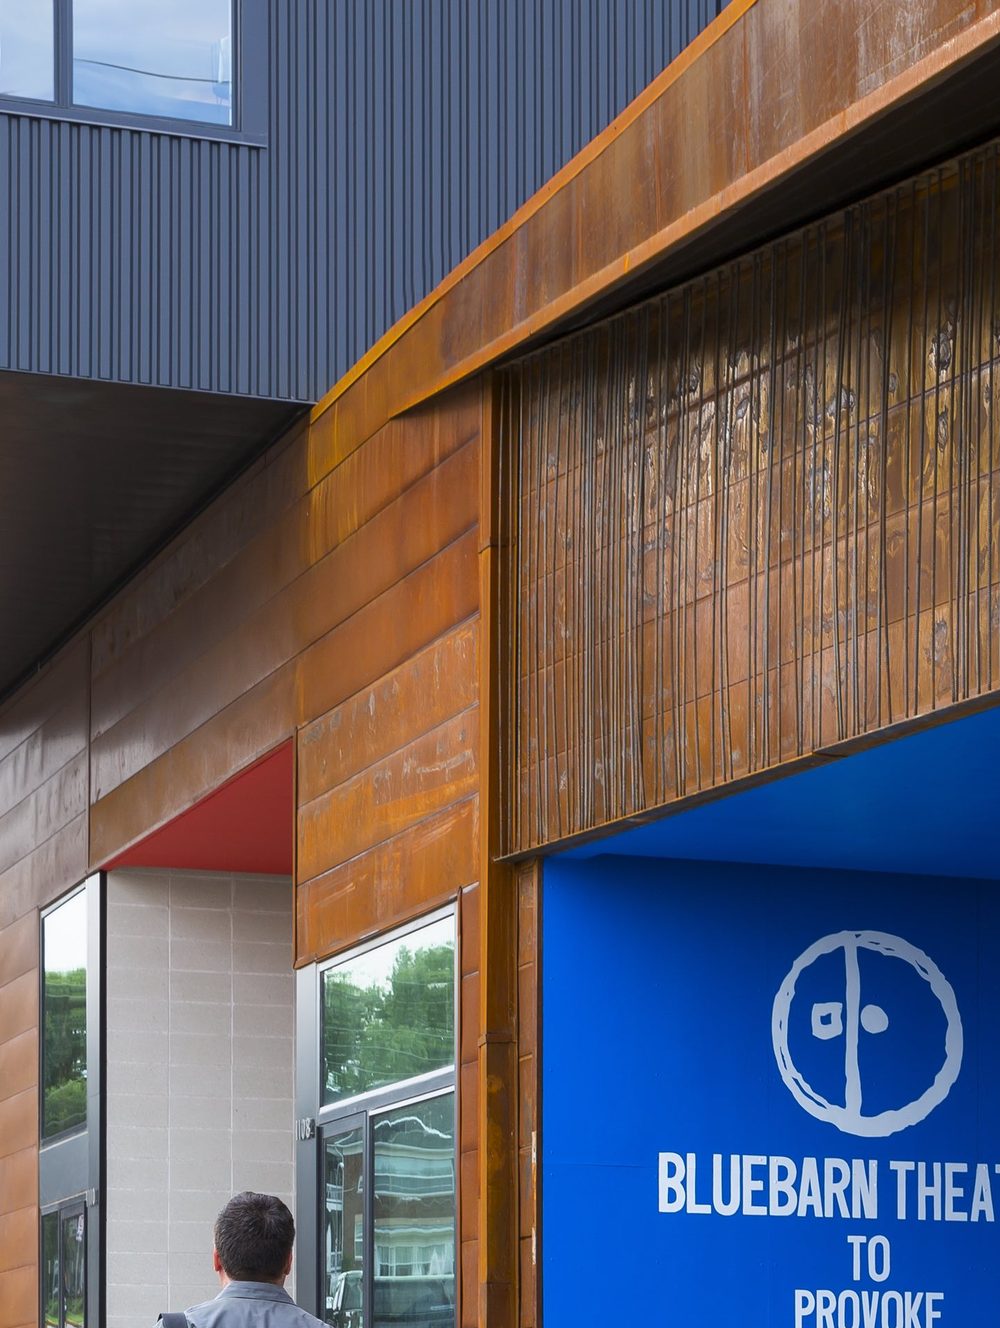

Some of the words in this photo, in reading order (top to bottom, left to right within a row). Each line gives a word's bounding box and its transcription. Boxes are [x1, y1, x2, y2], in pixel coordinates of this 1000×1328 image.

[295, 1117, 310, 1140] 1108
[659, 1152, 878, 1219] BLUEBARN
[847, 1235, 891, 1282] TO
